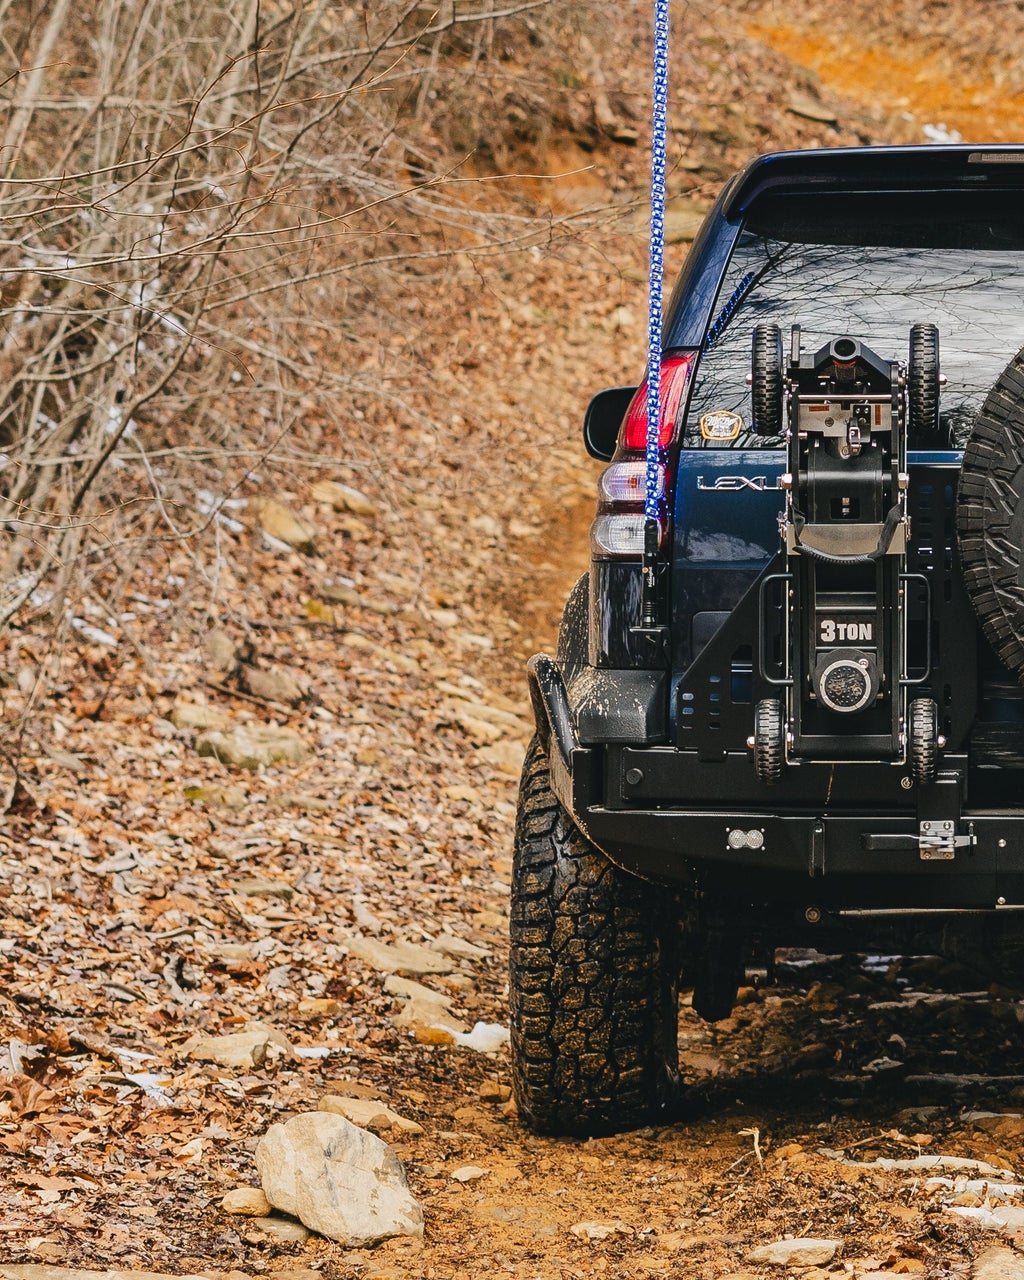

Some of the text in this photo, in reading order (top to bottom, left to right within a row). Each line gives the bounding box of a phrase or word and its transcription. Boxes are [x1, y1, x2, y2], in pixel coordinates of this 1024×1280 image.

[697, 475, 784, 490] LEXU
[820, 620, 873, 642] 3 TON
